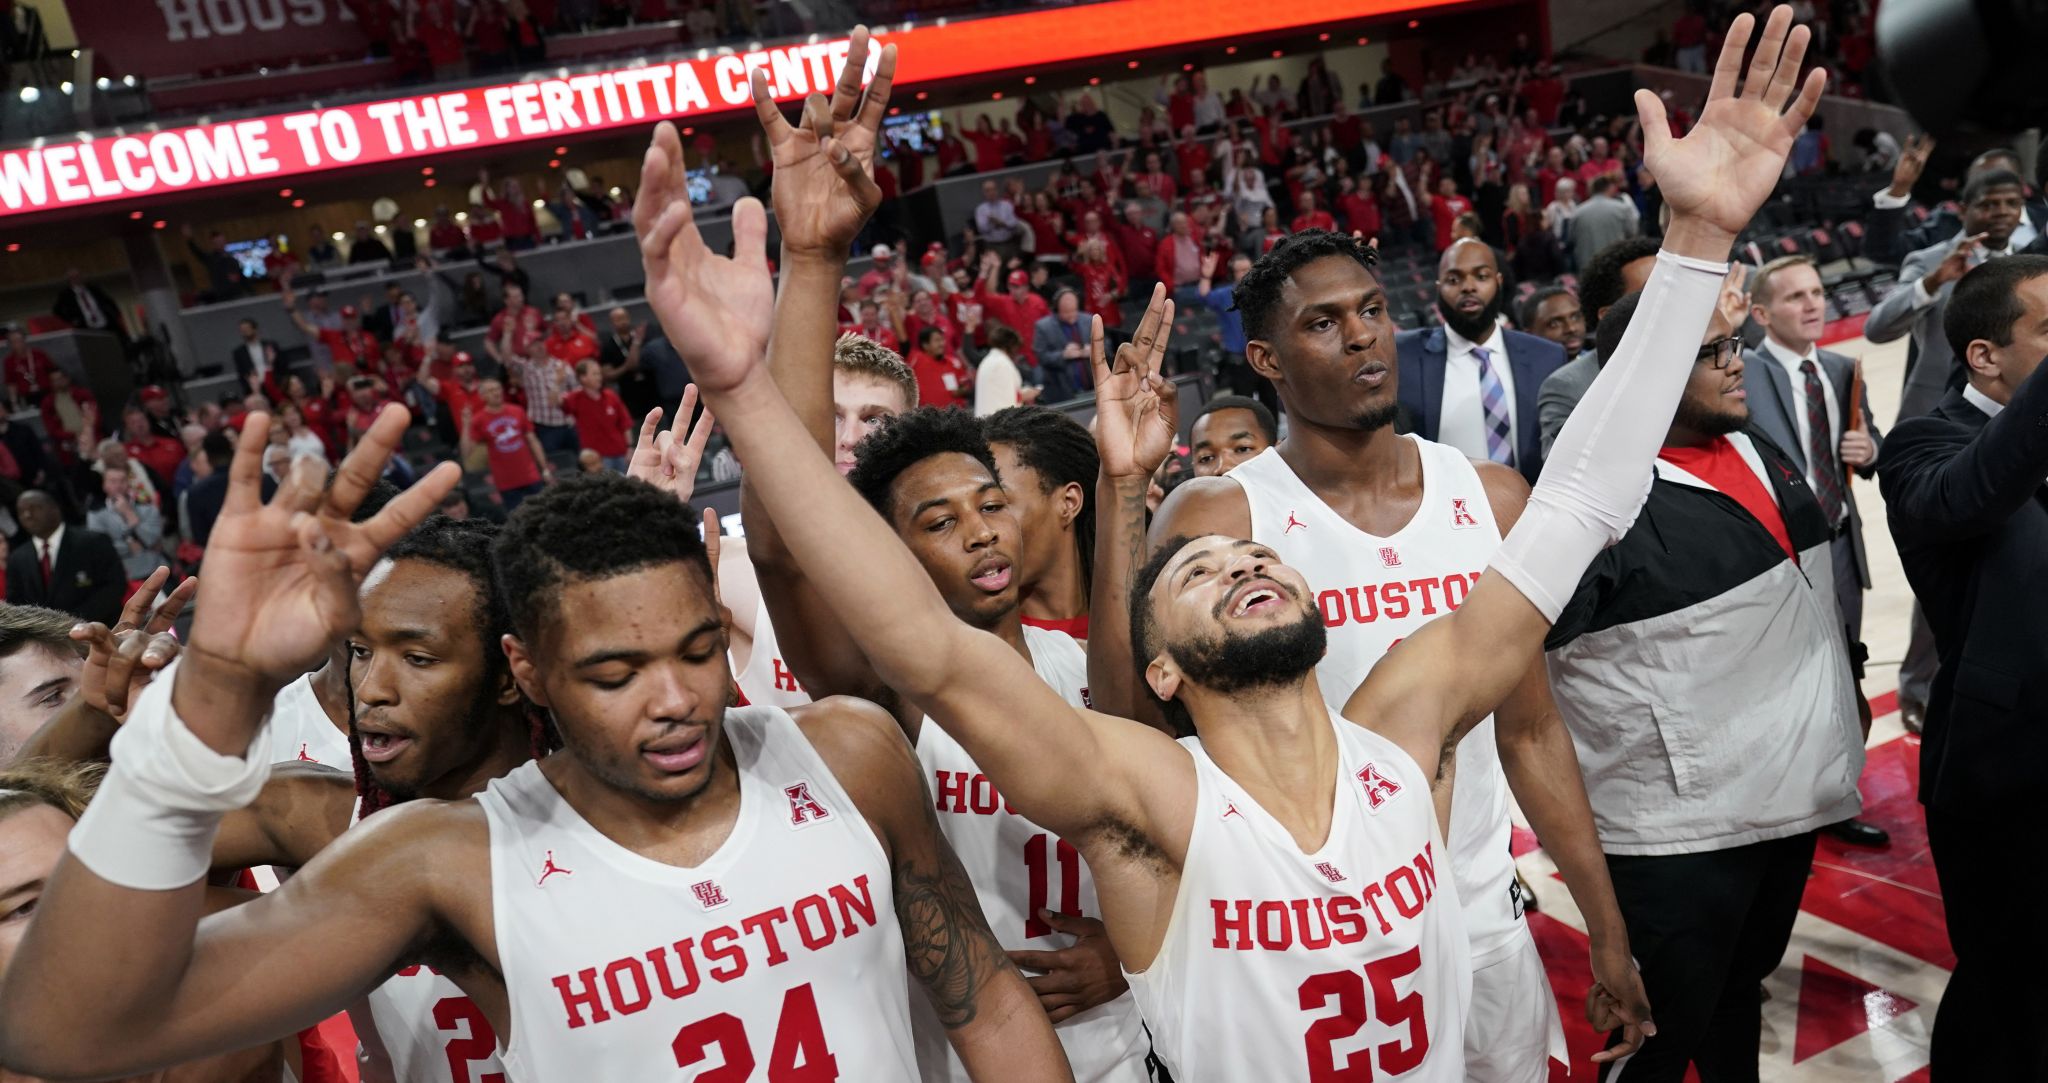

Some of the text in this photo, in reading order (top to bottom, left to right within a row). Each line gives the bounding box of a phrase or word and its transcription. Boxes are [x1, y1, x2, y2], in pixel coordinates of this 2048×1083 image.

[0, 120, 280, 209] WELCOME
[284, 110, 361, 167] TO
[368, 93, 478, 155] THE
[484, 62, 709, 139] FERTITTA
[1311, 571, 1483, 628] OUSTO
[1023, 834, 1083, 939] 11
[1210, 841, 1437, 951] HOUSTON
[551, 874, 877, 1029] HOUSTON
[671, 982, 838, 1083] 24
[1299, 945, 1430, 1083] 25
